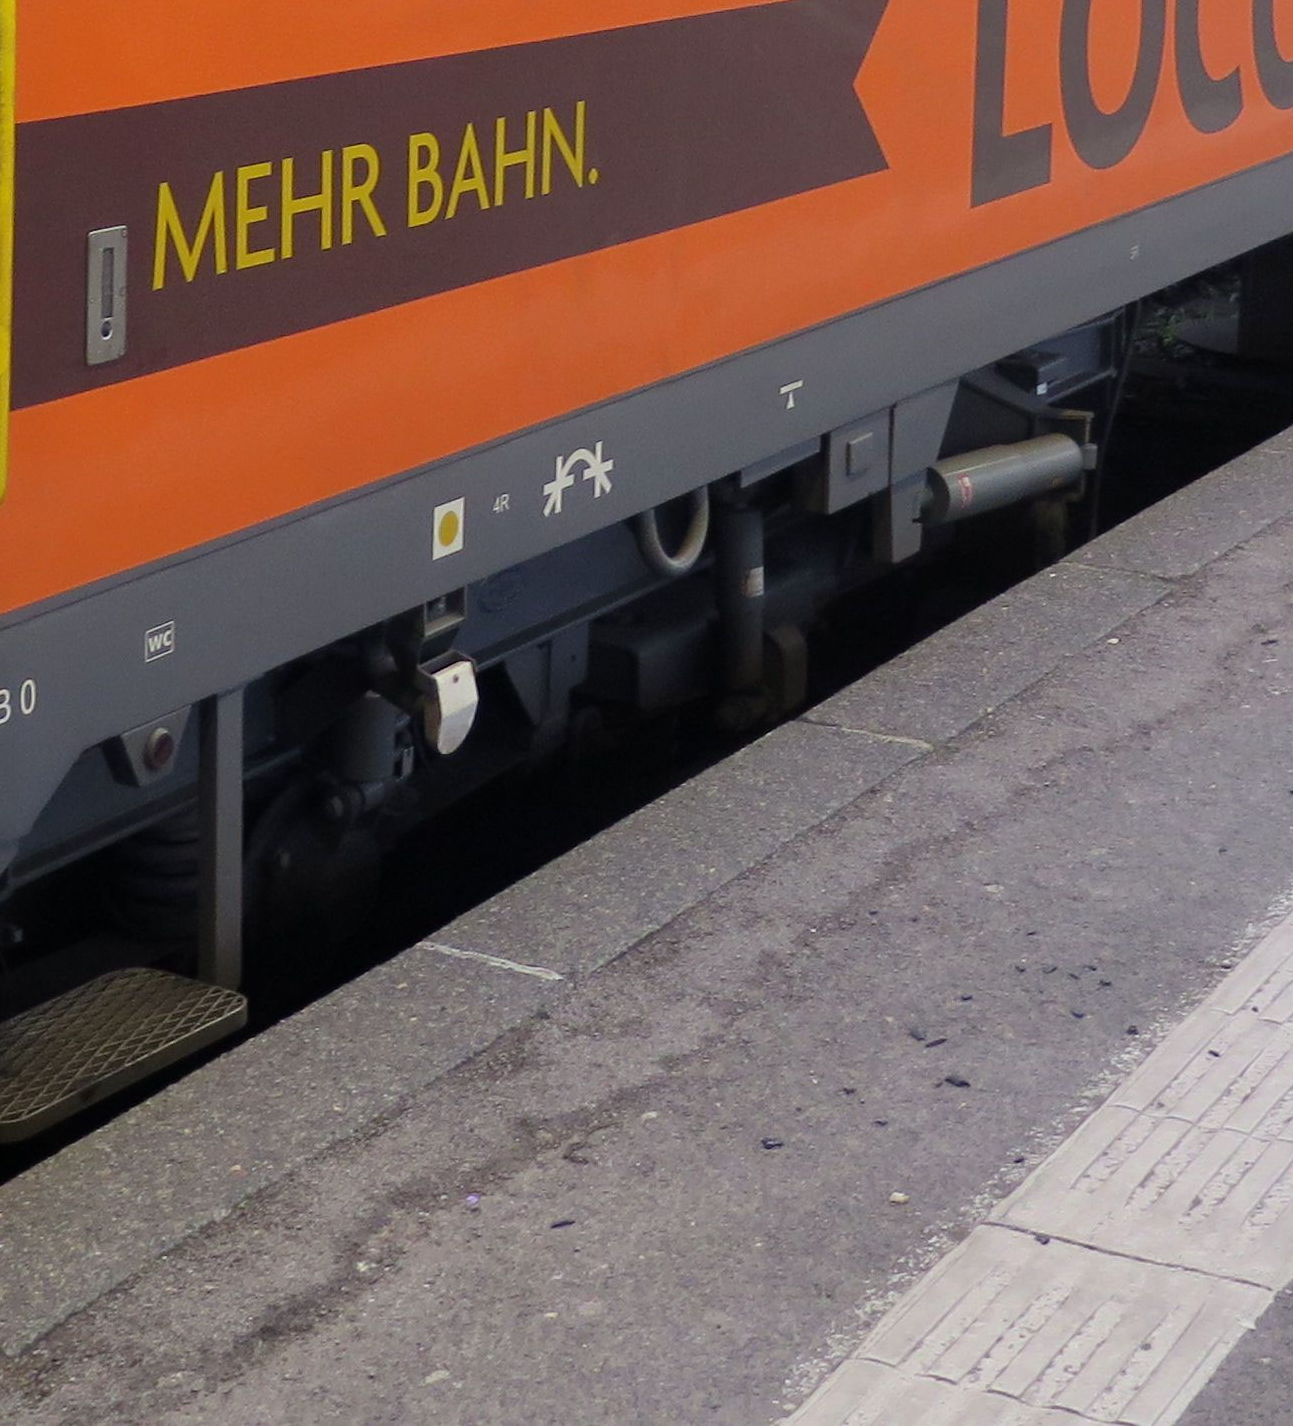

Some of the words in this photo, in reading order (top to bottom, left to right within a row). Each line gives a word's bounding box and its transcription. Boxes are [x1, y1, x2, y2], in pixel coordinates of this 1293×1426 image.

[152, 143, 387, 291] MEHR
[408, 100, 599, 230] BAHN.
[148, 629, 172, 652] WC
